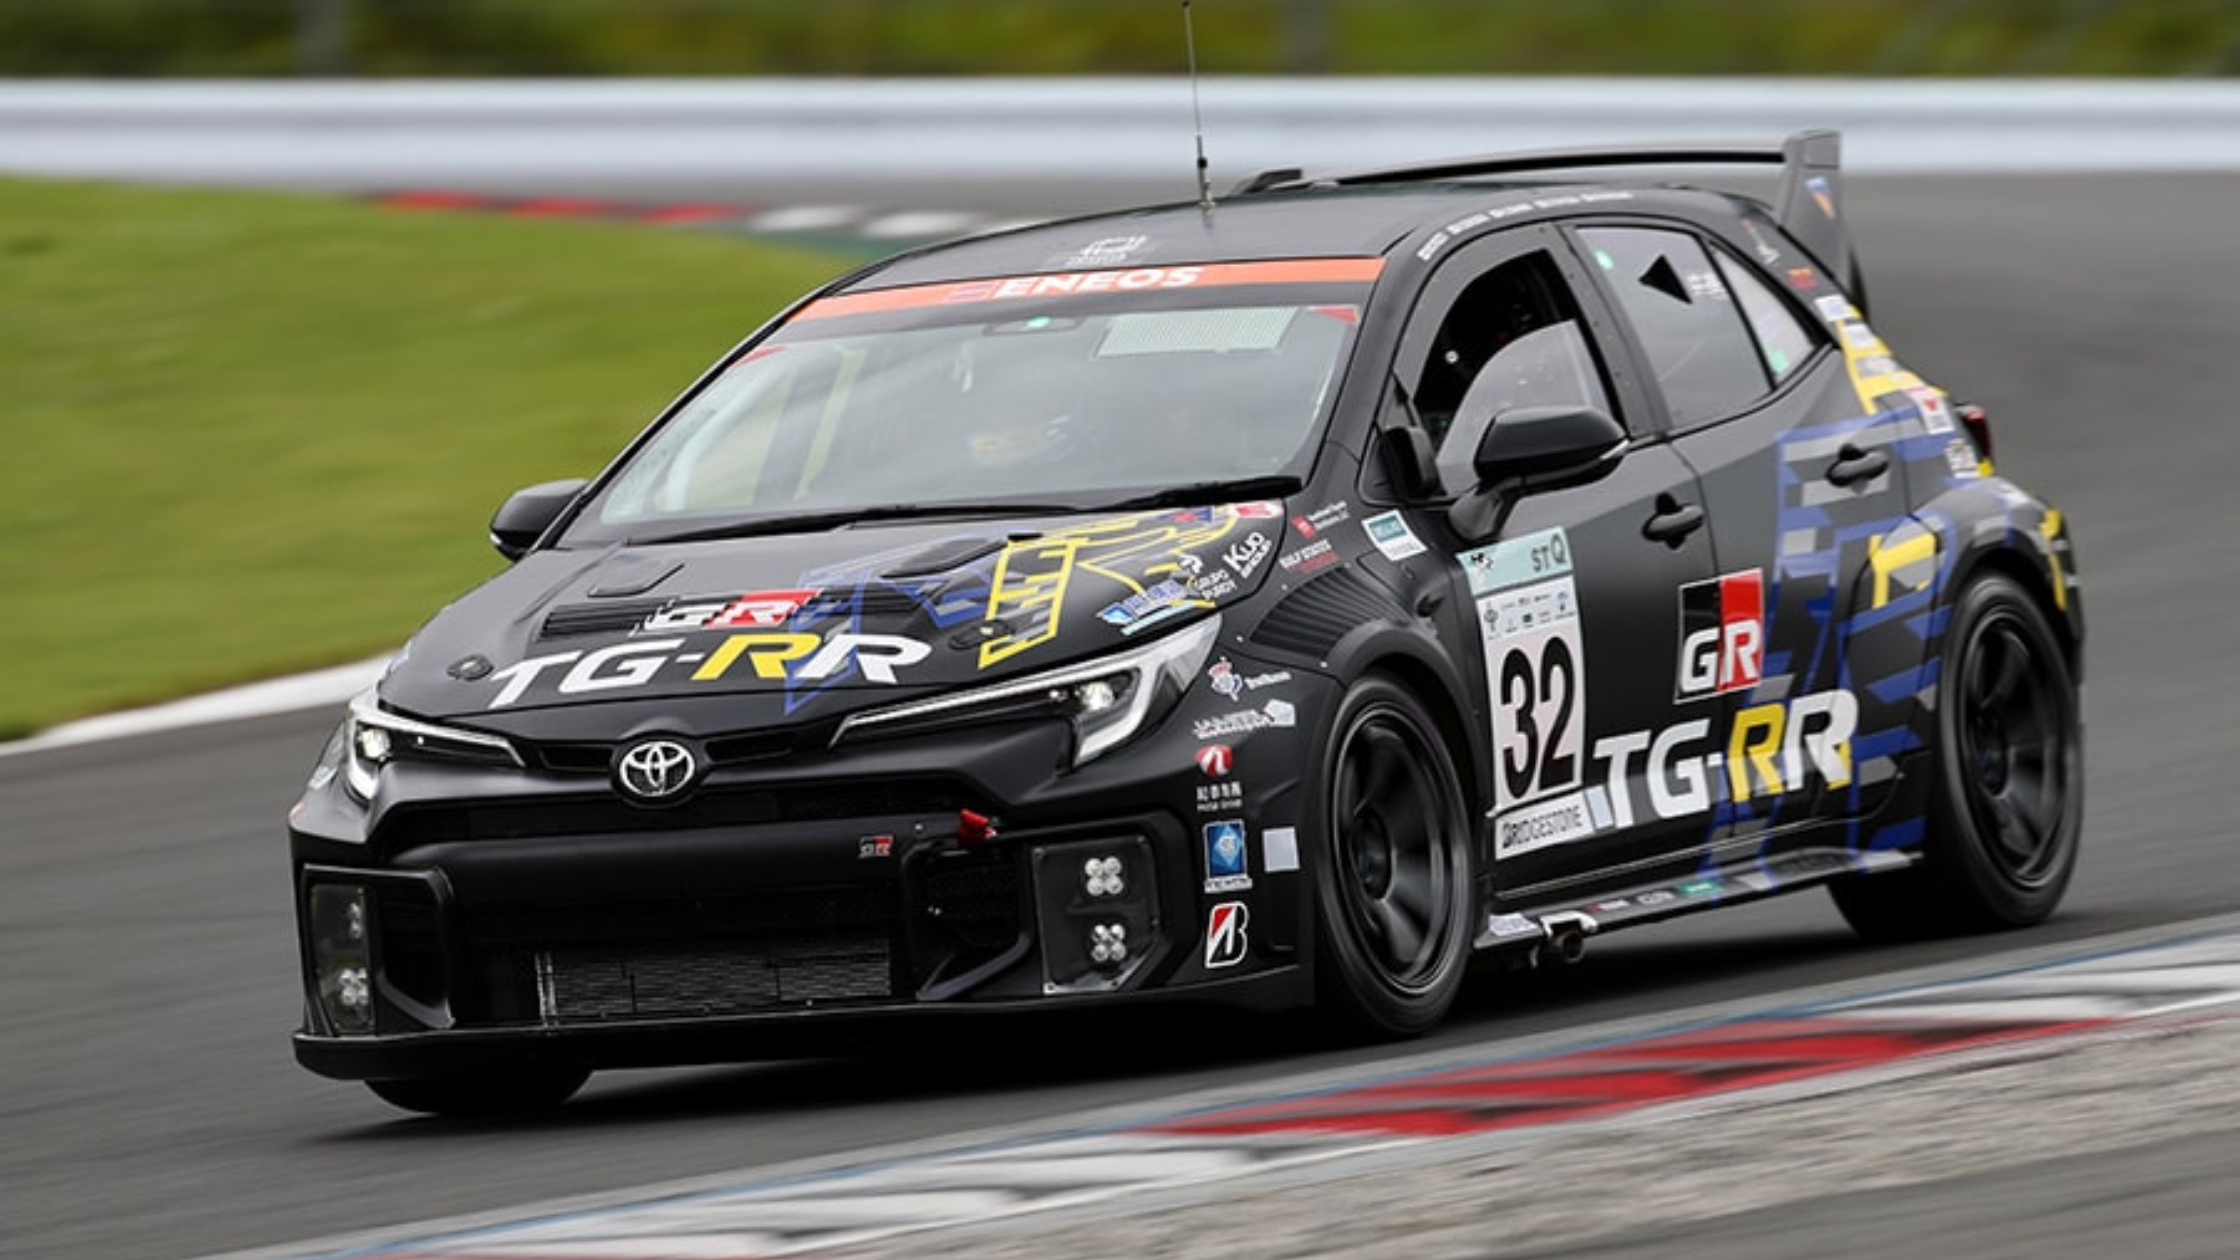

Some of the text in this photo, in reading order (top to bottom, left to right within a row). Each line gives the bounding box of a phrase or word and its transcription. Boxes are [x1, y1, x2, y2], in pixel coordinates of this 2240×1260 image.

[994, 266, 1204, 299] ENEOS
[643, 599, 803, 630] GR
[487, 633, 932, 710] TG-RR
[1681, 619, 1760, 693] GR
[1501, 636, 1575, 799] 32
[1593, 688, 1858, 829] TG-RR
[1503, 804, 1583, 849] BRIDGESTONE
